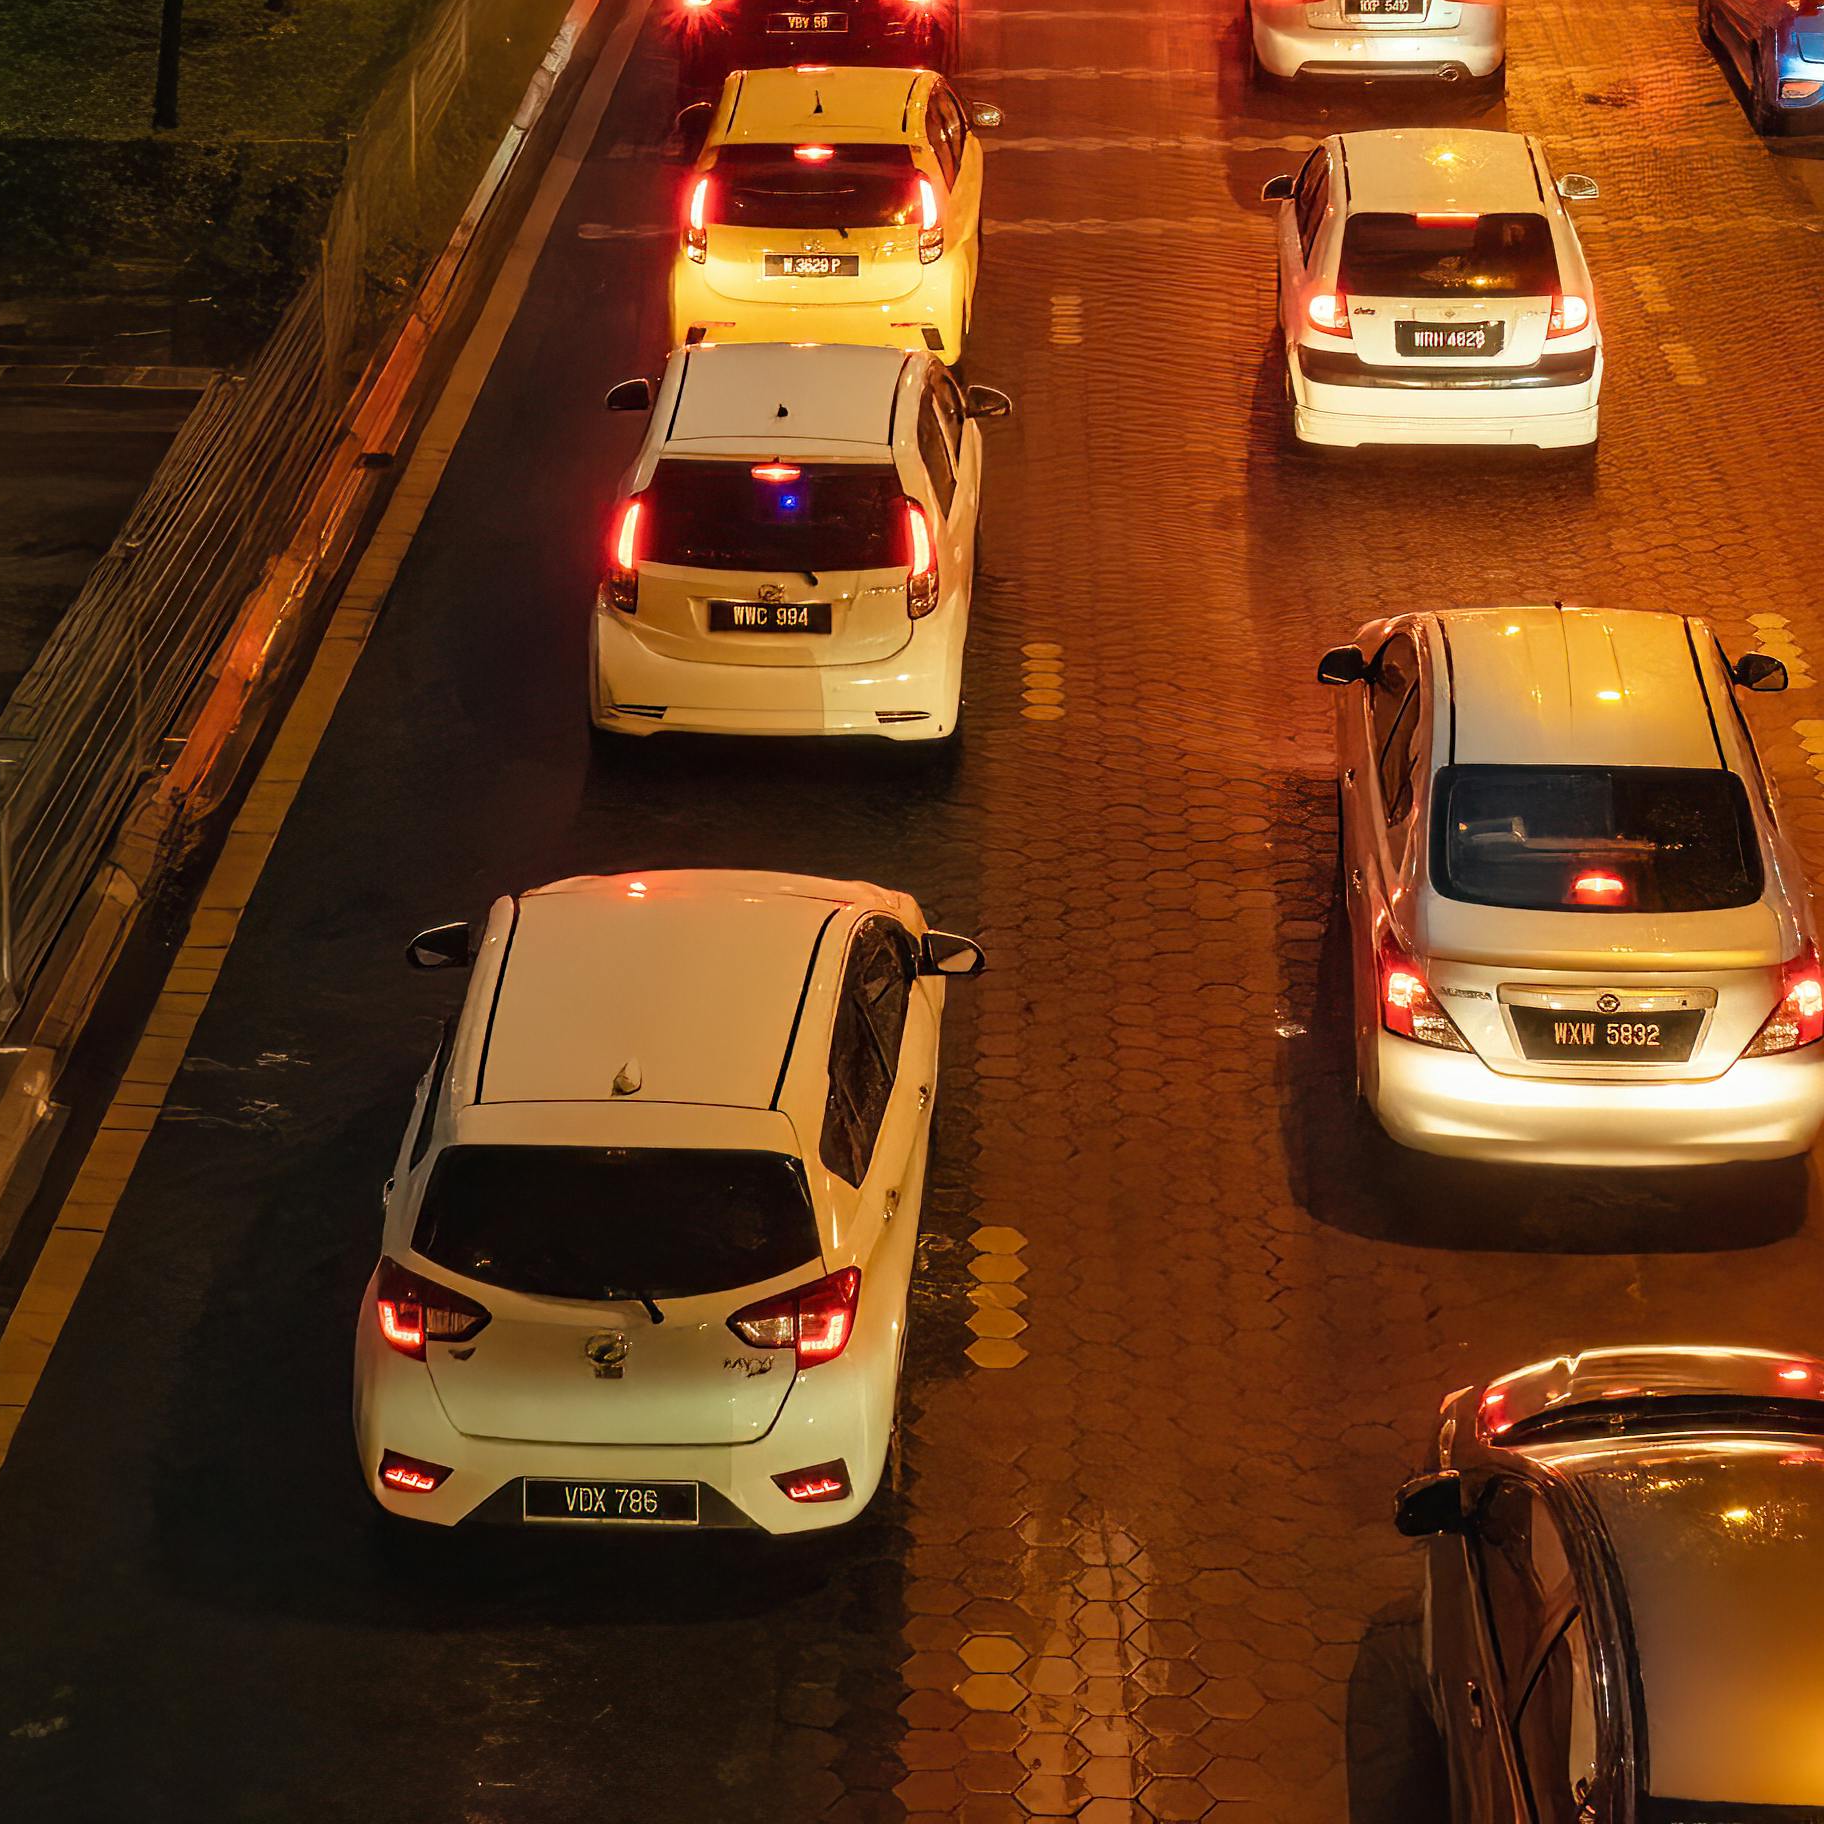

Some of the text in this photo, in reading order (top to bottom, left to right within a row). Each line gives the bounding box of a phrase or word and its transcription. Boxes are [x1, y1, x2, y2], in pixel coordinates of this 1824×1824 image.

[1554, 1022, 1661, 1046] WXW 5832
[565, 1486, 659, 1515] VDX 786
